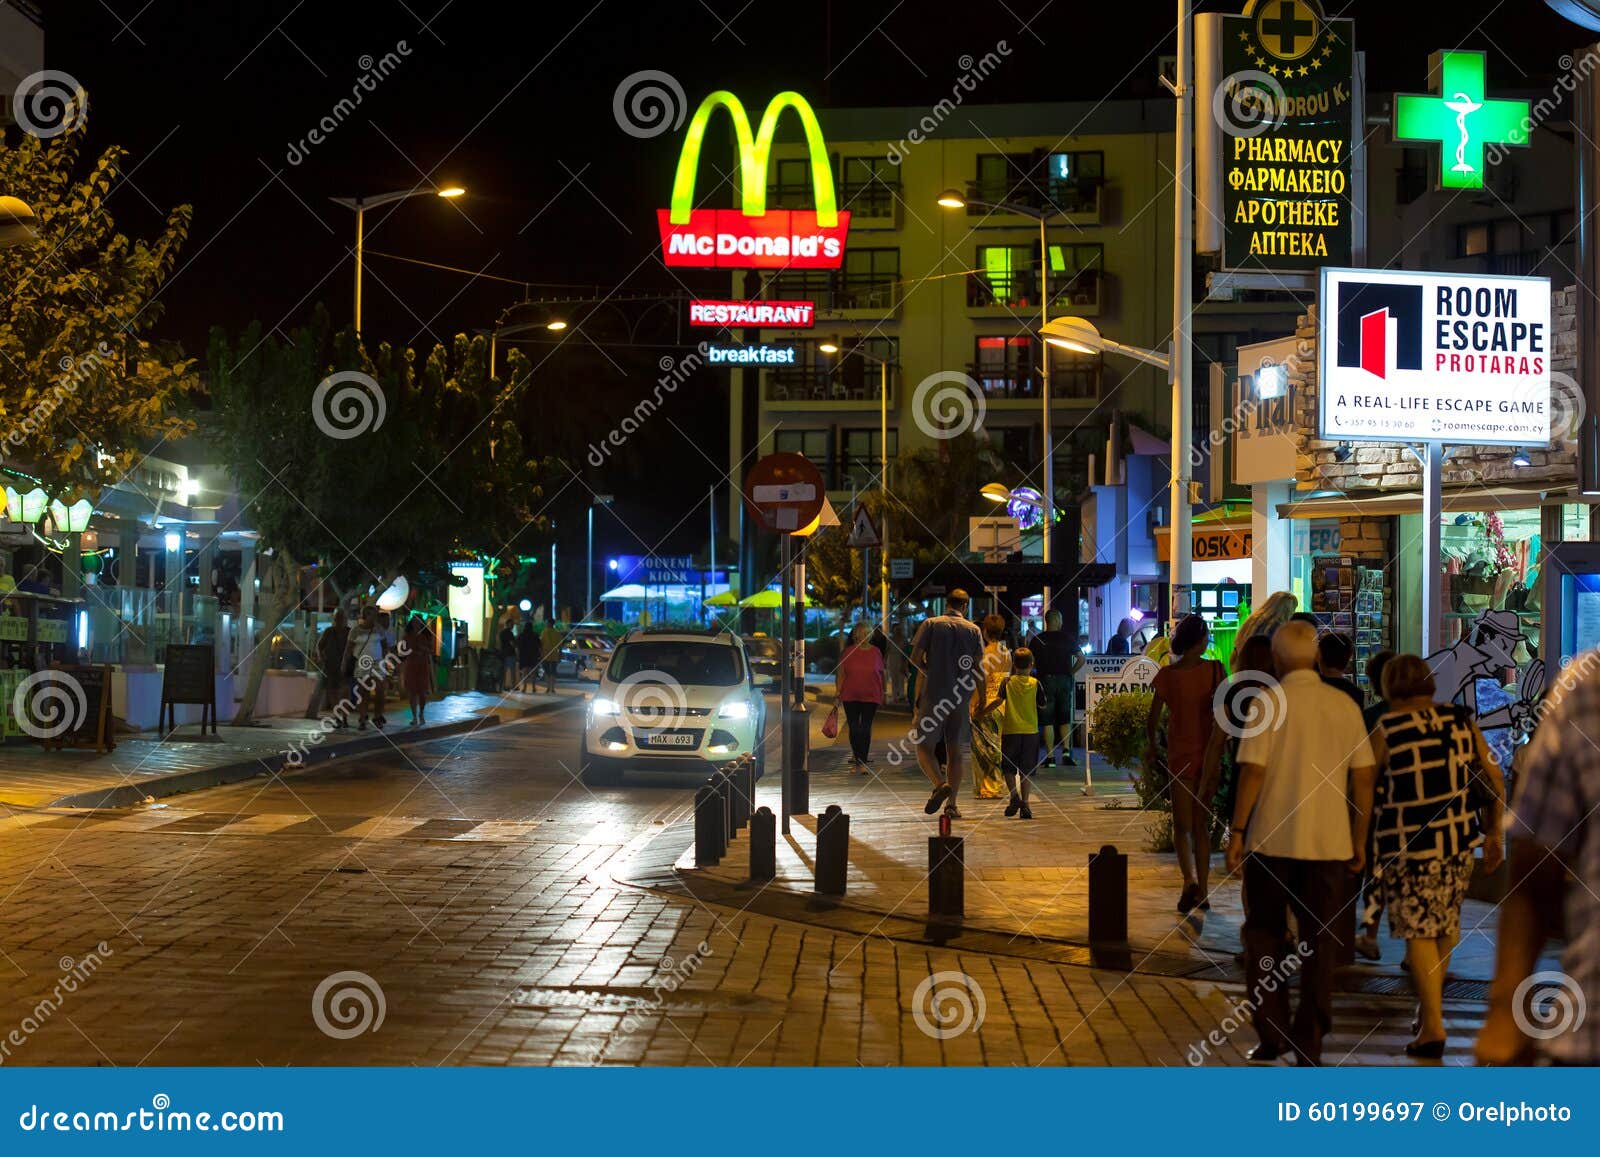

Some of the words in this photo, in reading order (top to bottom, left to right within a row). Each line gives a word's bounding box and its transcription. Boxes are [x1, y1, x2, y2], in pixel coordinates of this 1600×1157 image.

[1234, 137, 1343, 164] PHARMACY
[1228, 168, 1345, 194] ΦΑΡΜΑΚΕΙΟ
[1234, 200, 1339, 227] APOTHEKE
[1437, 286, 1518, 318] ROOM
[690, 304, 814, 324] RESTAURANT
[1436, 320, 1544, 353] ESCAPE
[709, 346, 795, 363] breakfast
[1436, 354, 1543, 375] PROTARAS
[1337, 395, 1347, 407] A
[1353, 395, 1430, 410] REAL-LIFE
[1436, 398, 1493, 412] ESCAPE
[1498, 400, 1544, 414] GAME
[1443, 422, 1544, 434] roomescape.com.cy
[1192, 535, 1230, 558] IOSK
[650, 571, 688, 582] KIOSK
[675, 736, 691, 744] 693
